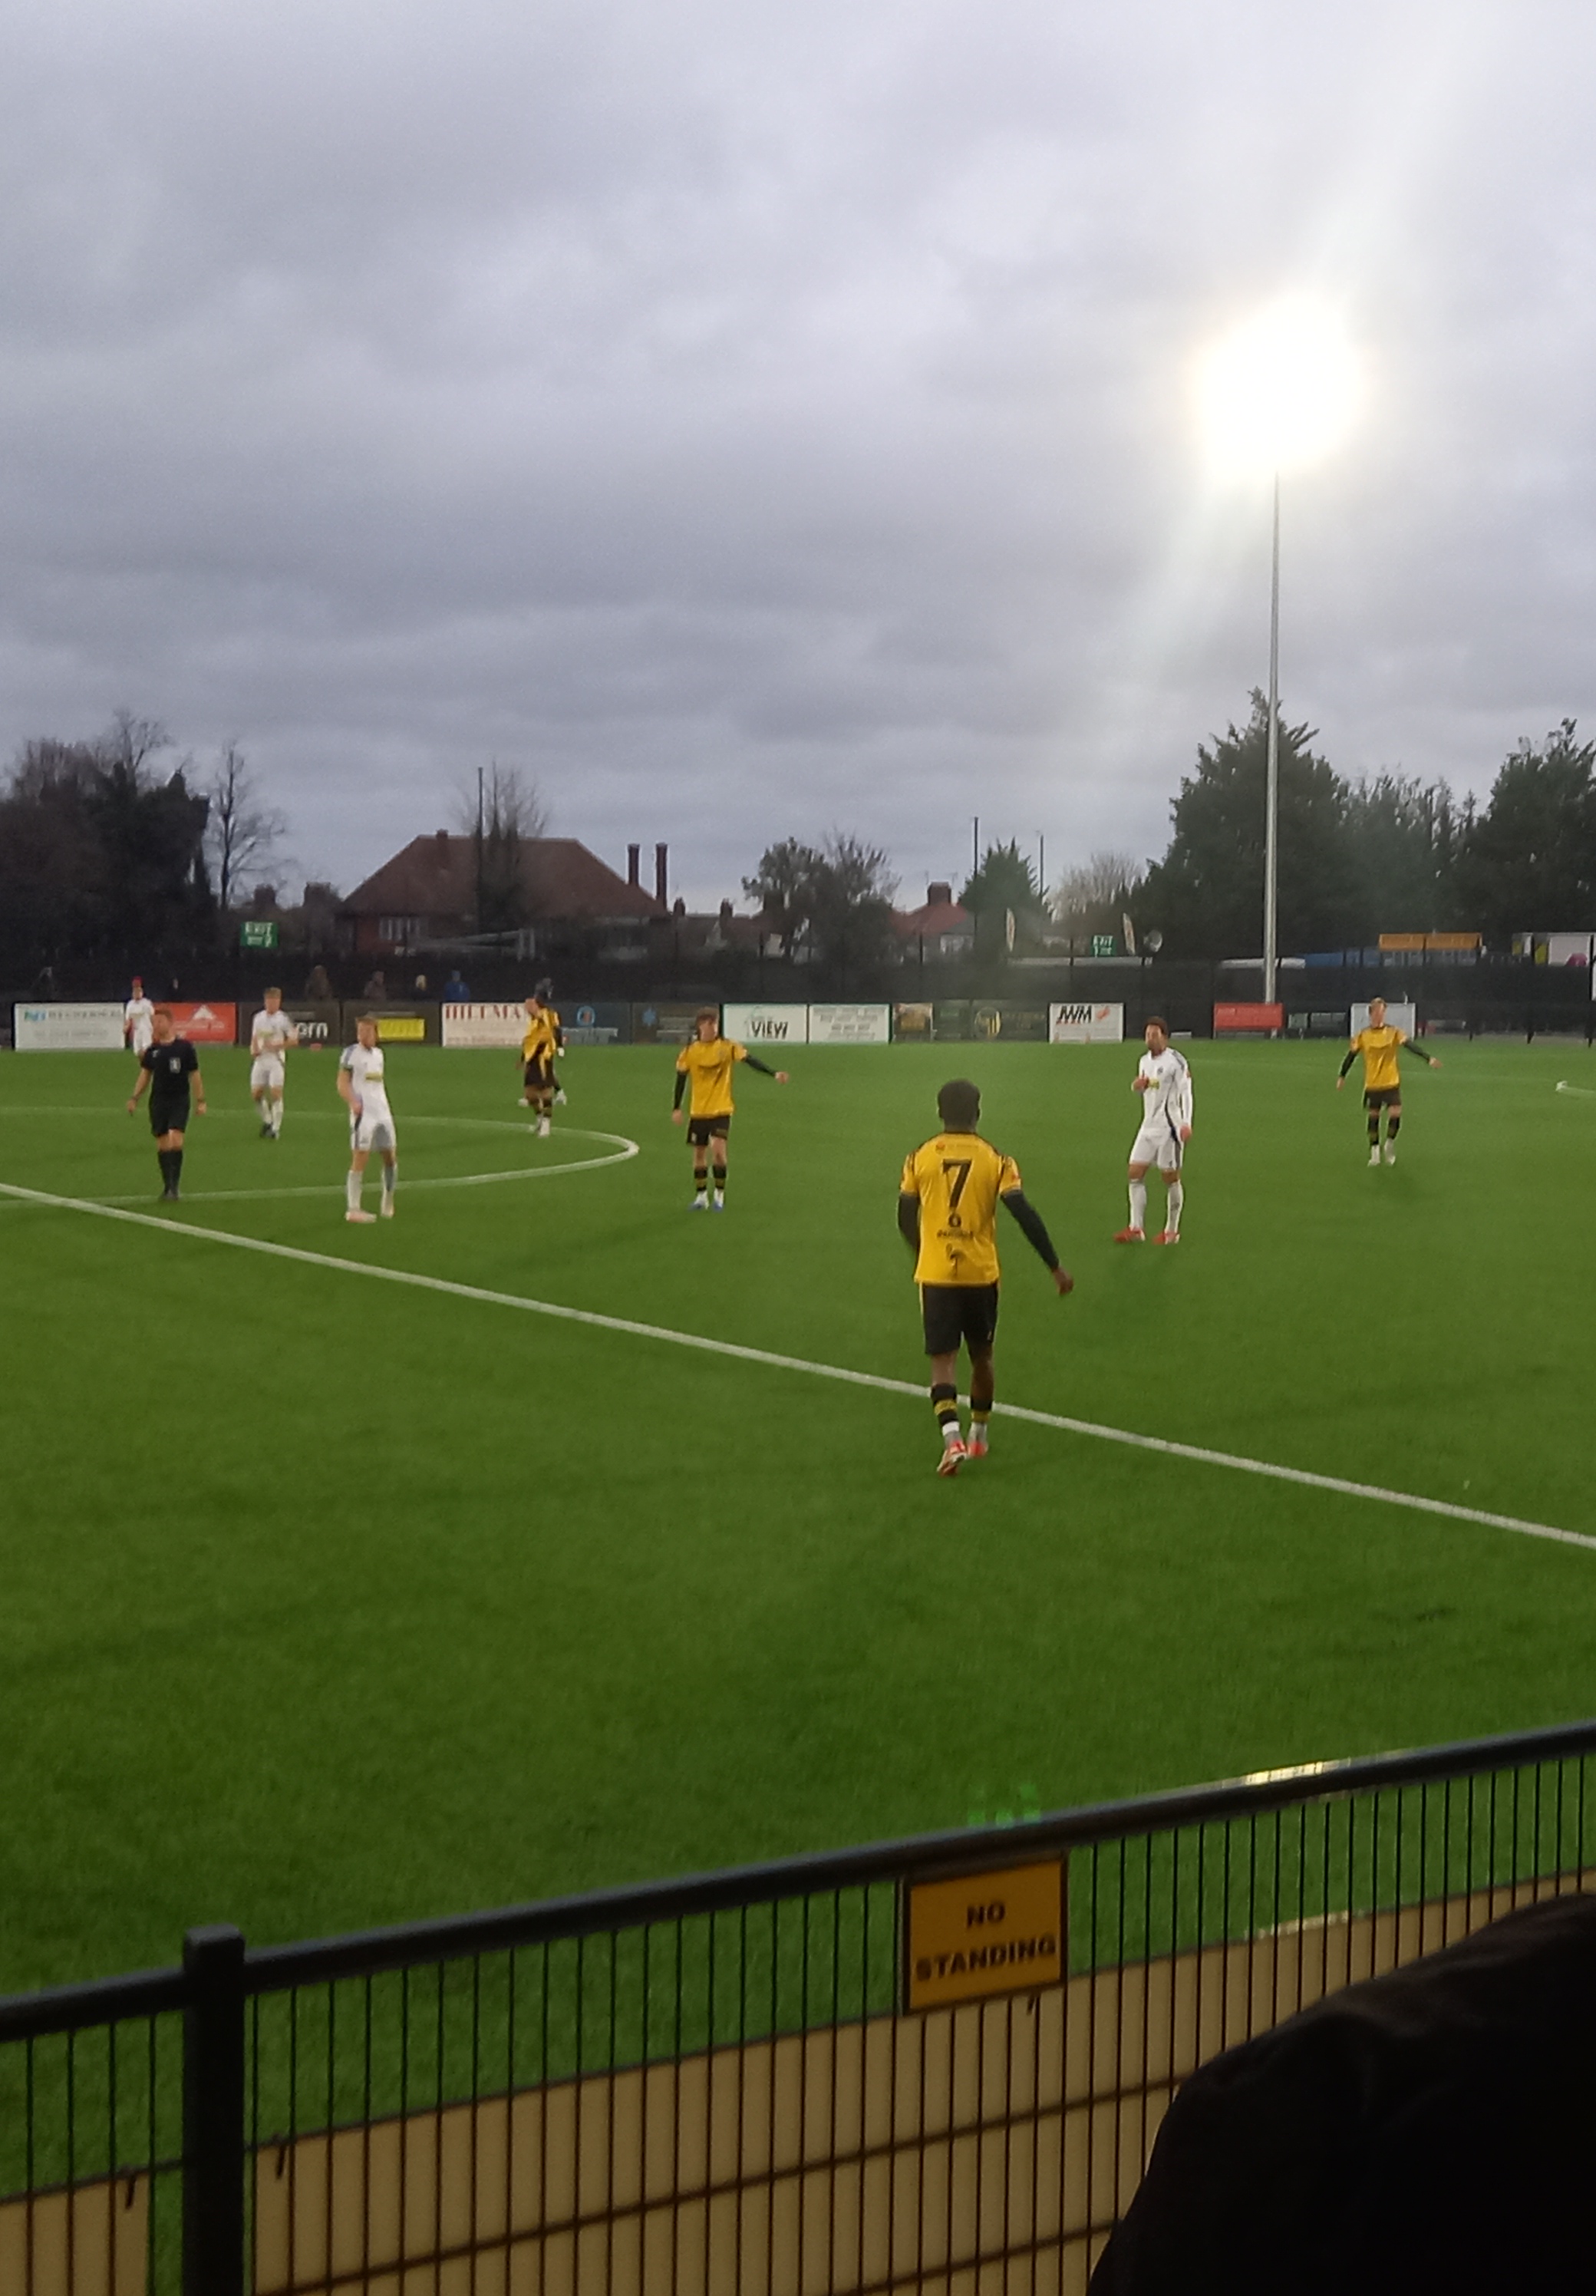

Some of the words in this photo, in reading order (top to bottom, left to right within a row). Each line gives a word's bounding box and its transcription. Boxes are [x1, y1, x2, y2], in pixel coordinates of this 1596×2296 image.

[942, 1159, 972, 1208] 7
[967, 1900, 1005, 1928] NO
[916, 1933, 1056, 1981] STANDING
